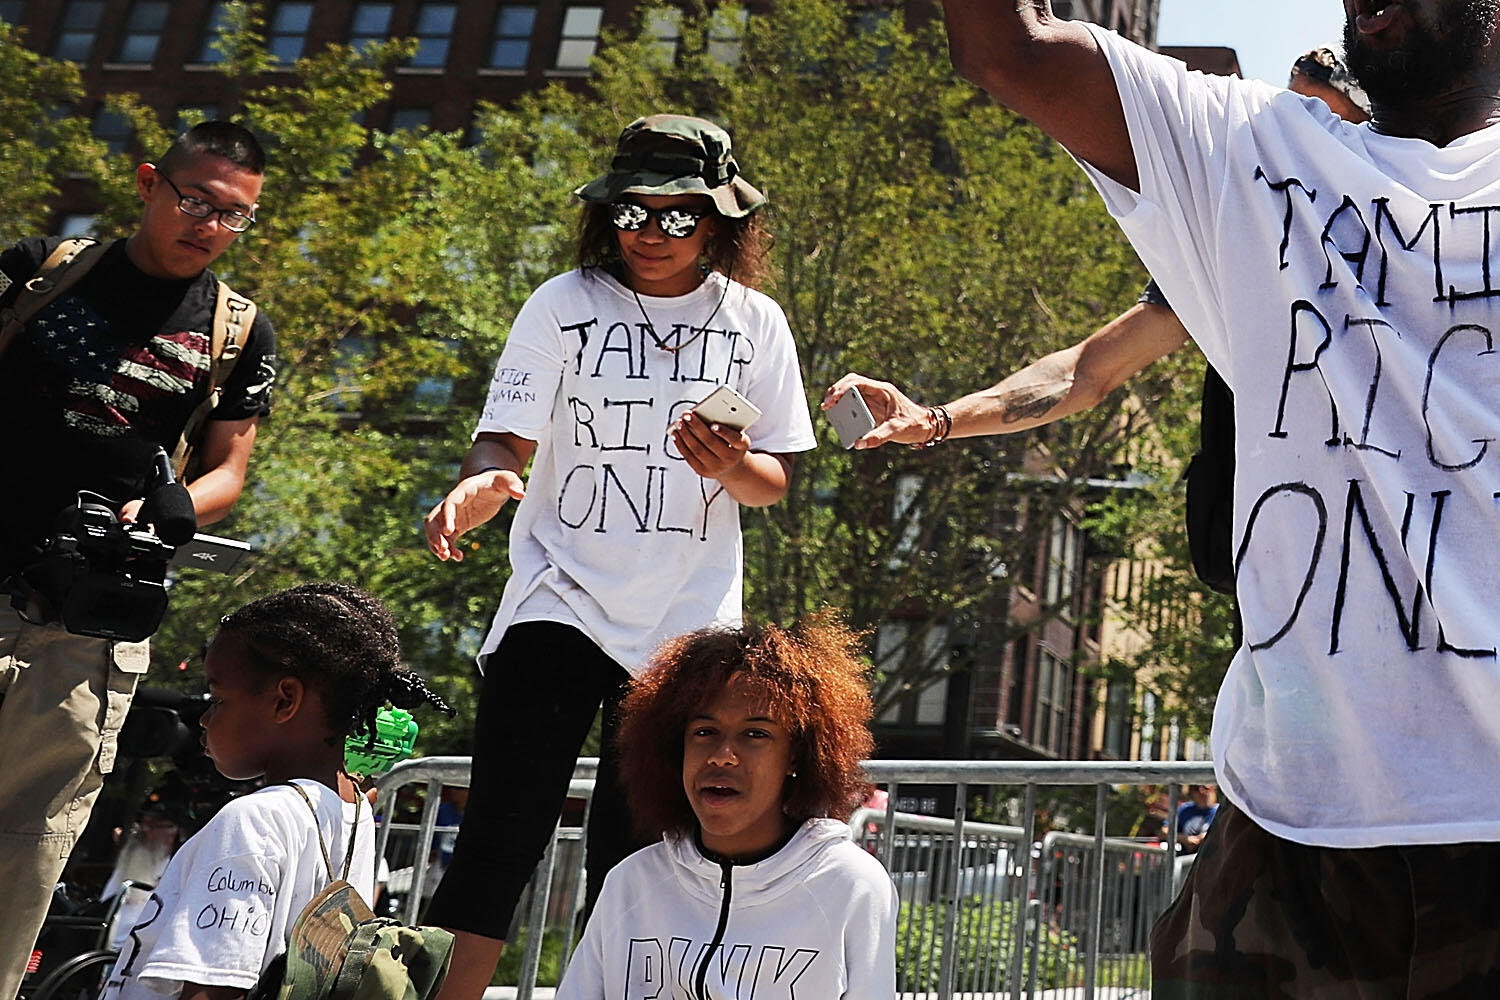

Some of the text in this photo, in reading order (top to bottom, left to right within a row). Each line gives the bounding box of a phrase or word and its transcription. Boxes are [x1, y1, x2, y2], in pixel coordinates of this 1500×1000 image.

[560, 317, 755, 391] TAMIR
[558, 463, 726, 542] ONLY
[192, 552, 218, 562] 4K
[624, 937, 820, 1000] PINK
